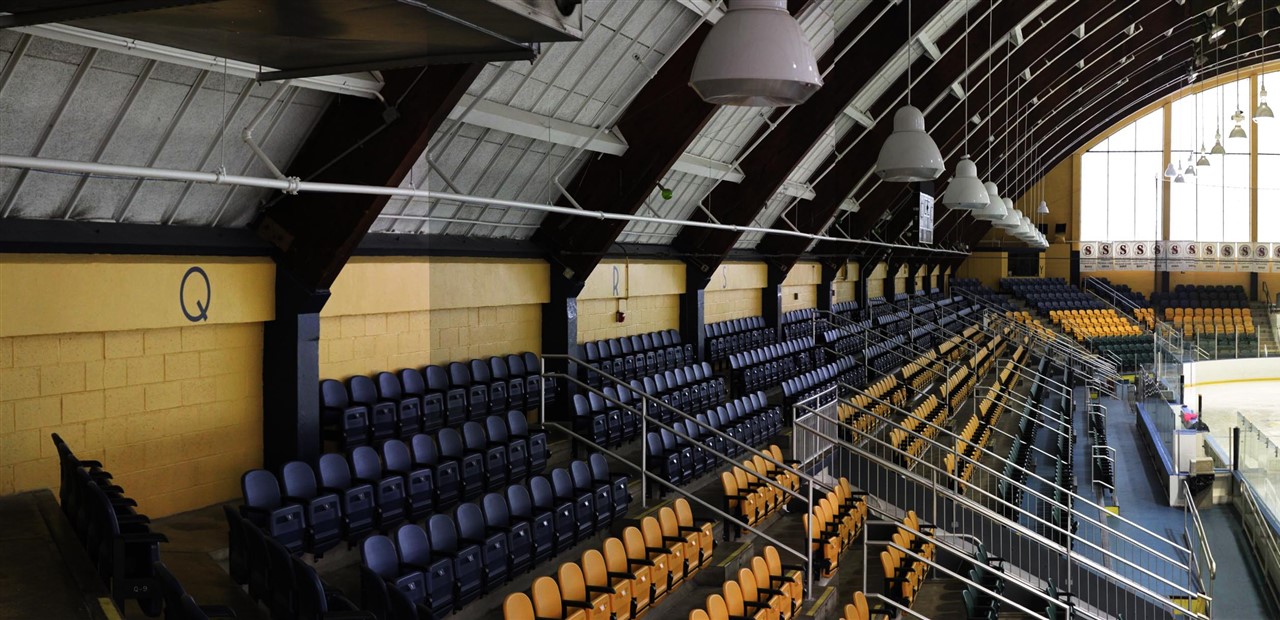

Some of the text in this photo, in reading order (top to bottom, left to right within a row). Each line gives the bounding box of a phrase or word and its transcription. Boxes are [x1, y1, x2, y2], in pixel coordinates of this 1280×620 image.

[612, 266, 619, 296] R
[722, 266, 727, 288] S
[1040, 266, 1044, 274] Y
[180, 266, 211, 322] Q
